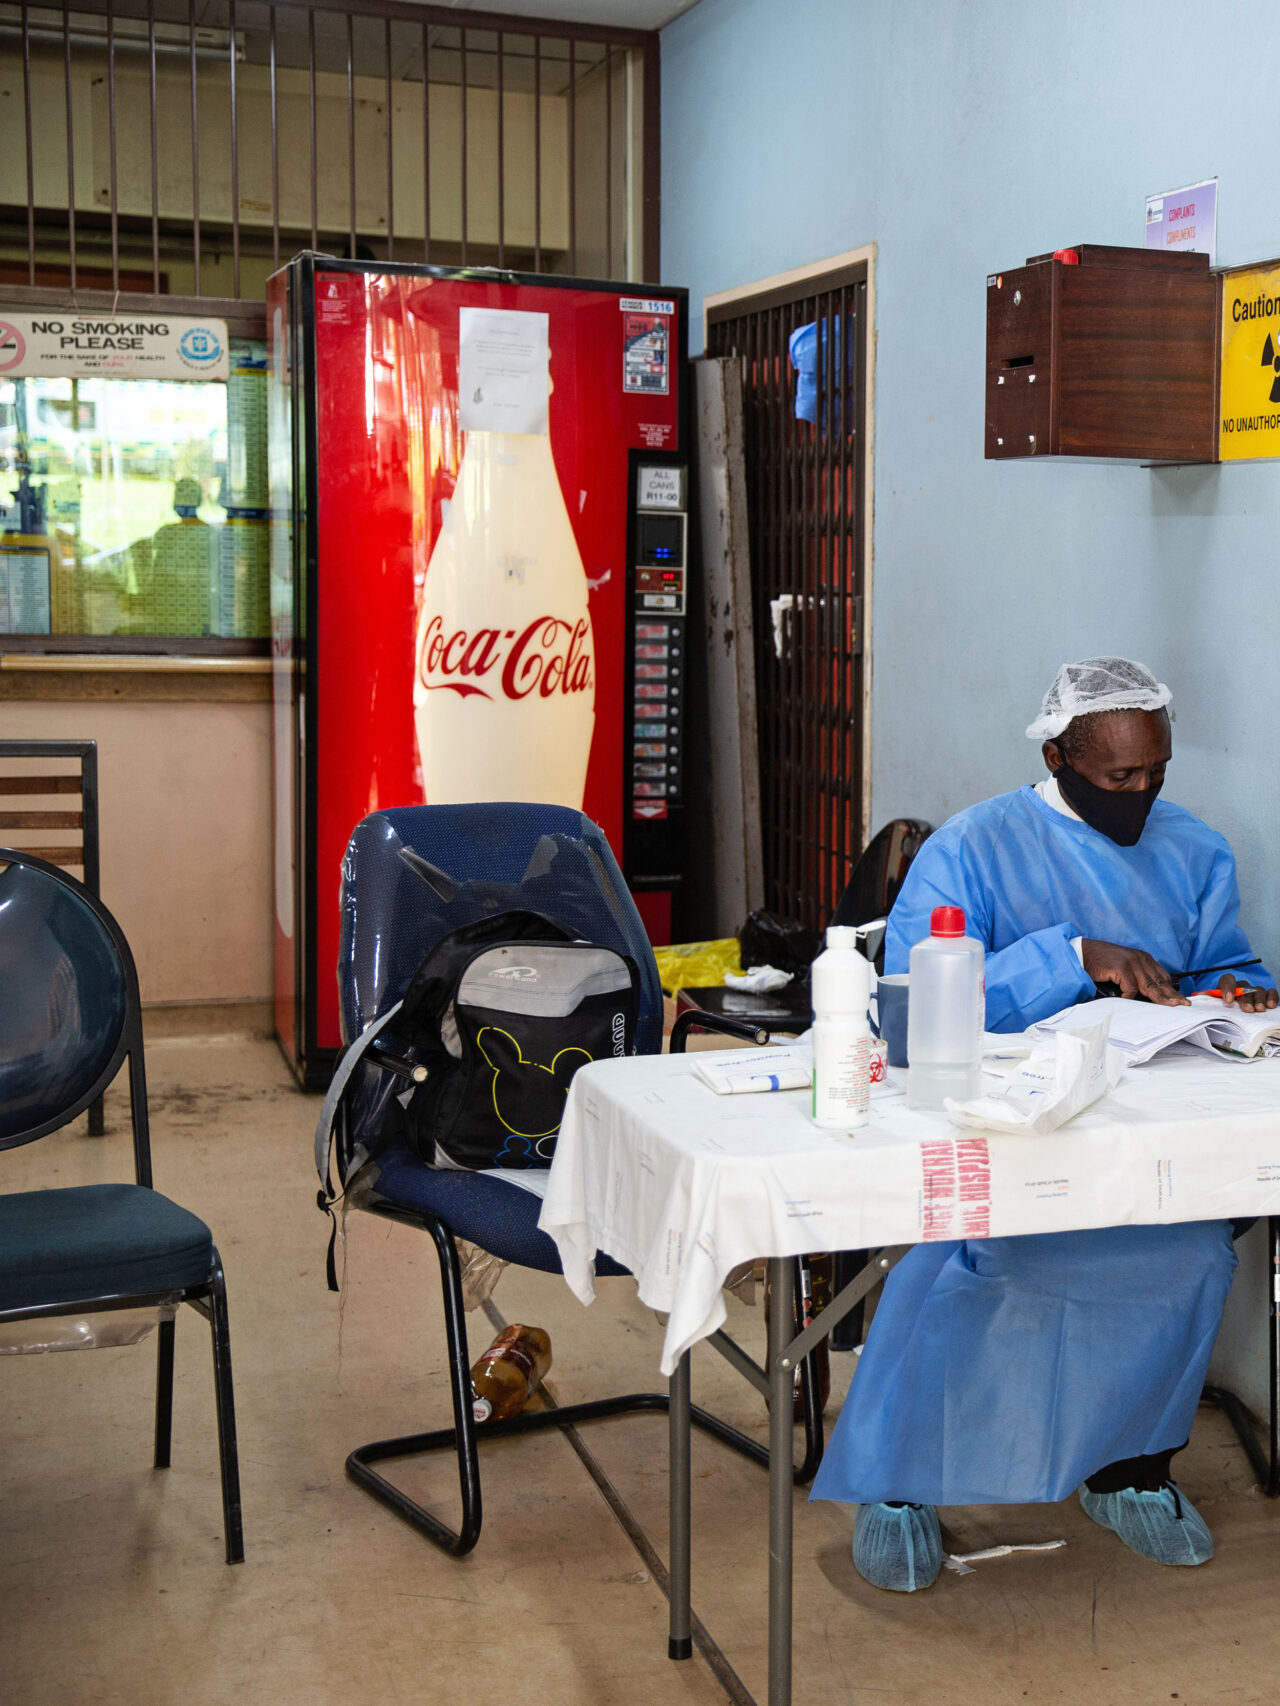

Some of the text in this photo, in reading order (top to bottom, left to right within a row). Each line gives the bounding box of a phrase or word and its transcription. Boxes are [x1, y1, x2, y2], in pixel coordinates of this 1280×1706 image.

[648, 301, 672, 313] 1516
[31, 321, 170, 336] NO SMOKING
[60, 336, 145, 350] PLEASE
[1222, 418, 1235, 433] NO
[654, 470, 671, 479] ALL
[649, 481, 675, 490] CANS
[420, 615, 592, 702] Coca-Cola
[922, 1204, 955, 1243] ORGE
